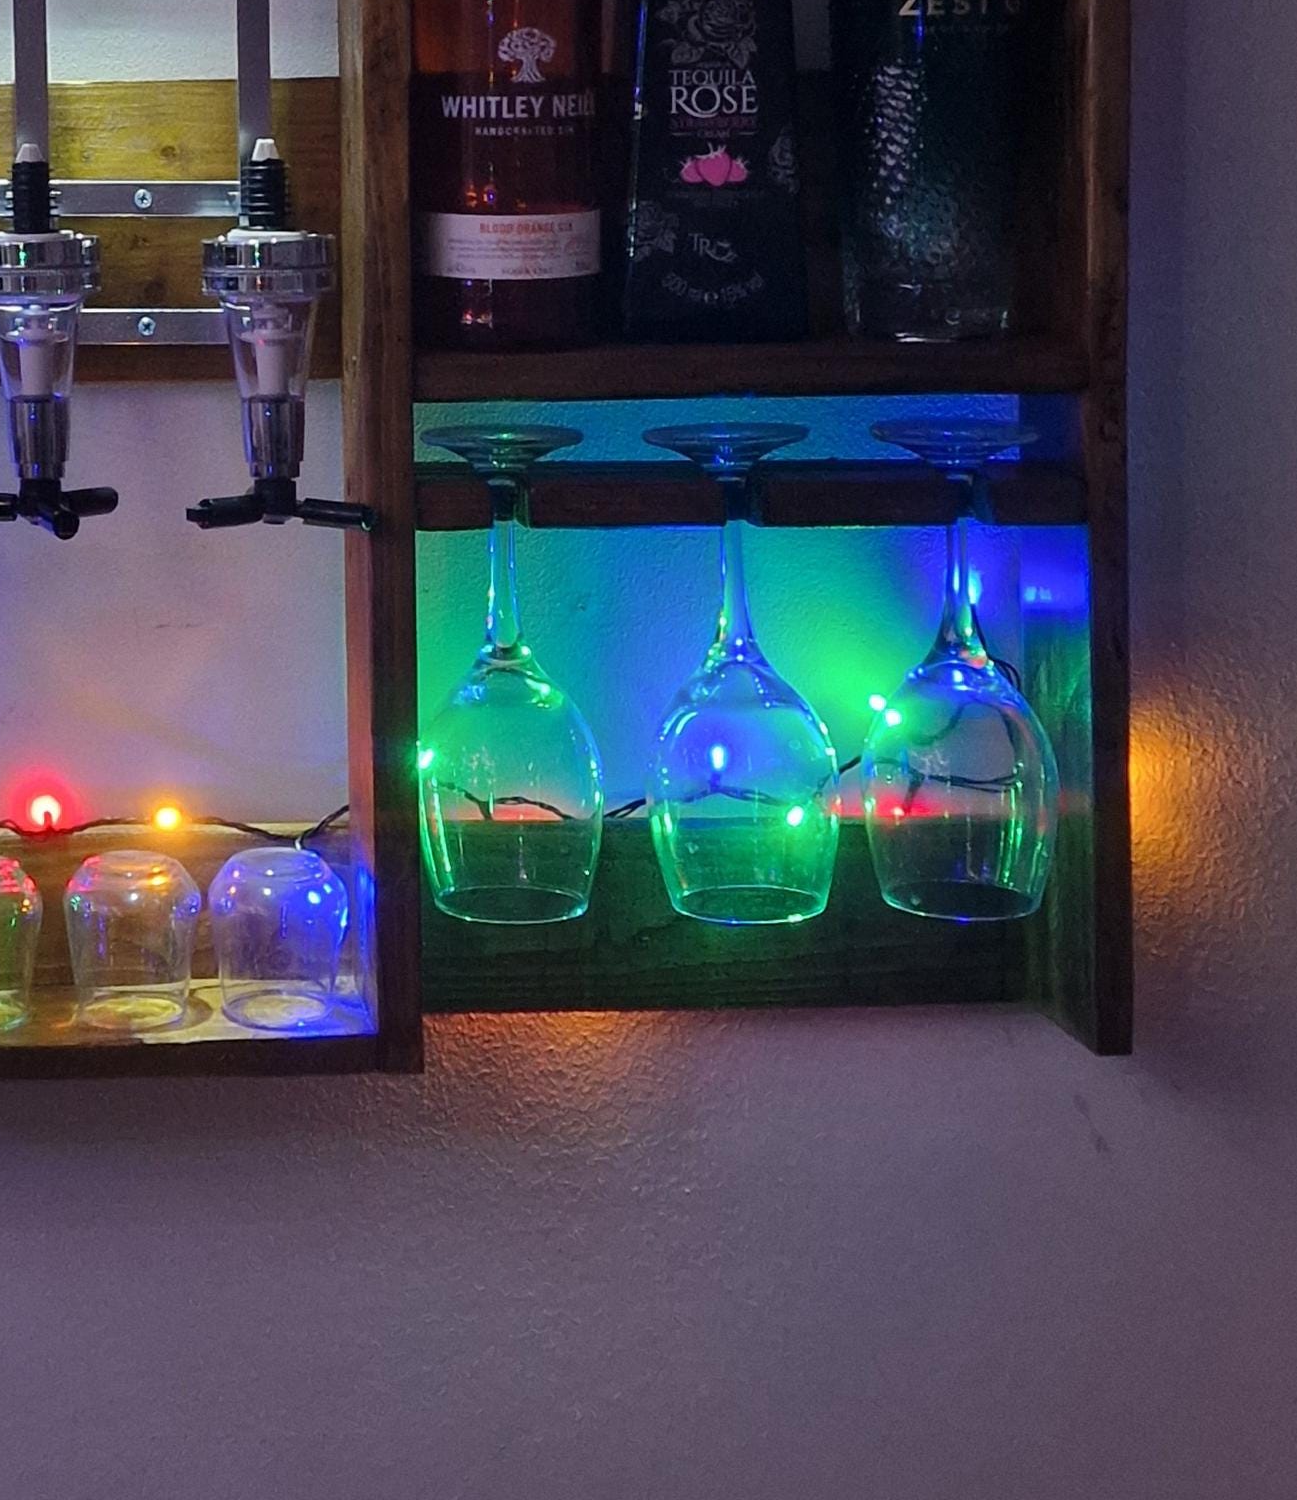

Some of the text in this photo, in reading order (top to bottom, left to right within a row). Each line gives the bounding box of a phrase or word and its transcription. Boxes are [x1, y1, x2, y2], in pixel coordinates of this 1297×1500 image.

[668, 68, 757, 87] TEQUILA
[441, 95, 545, 118] WHITLEY
[670, 84, 759, 119] ROSE
